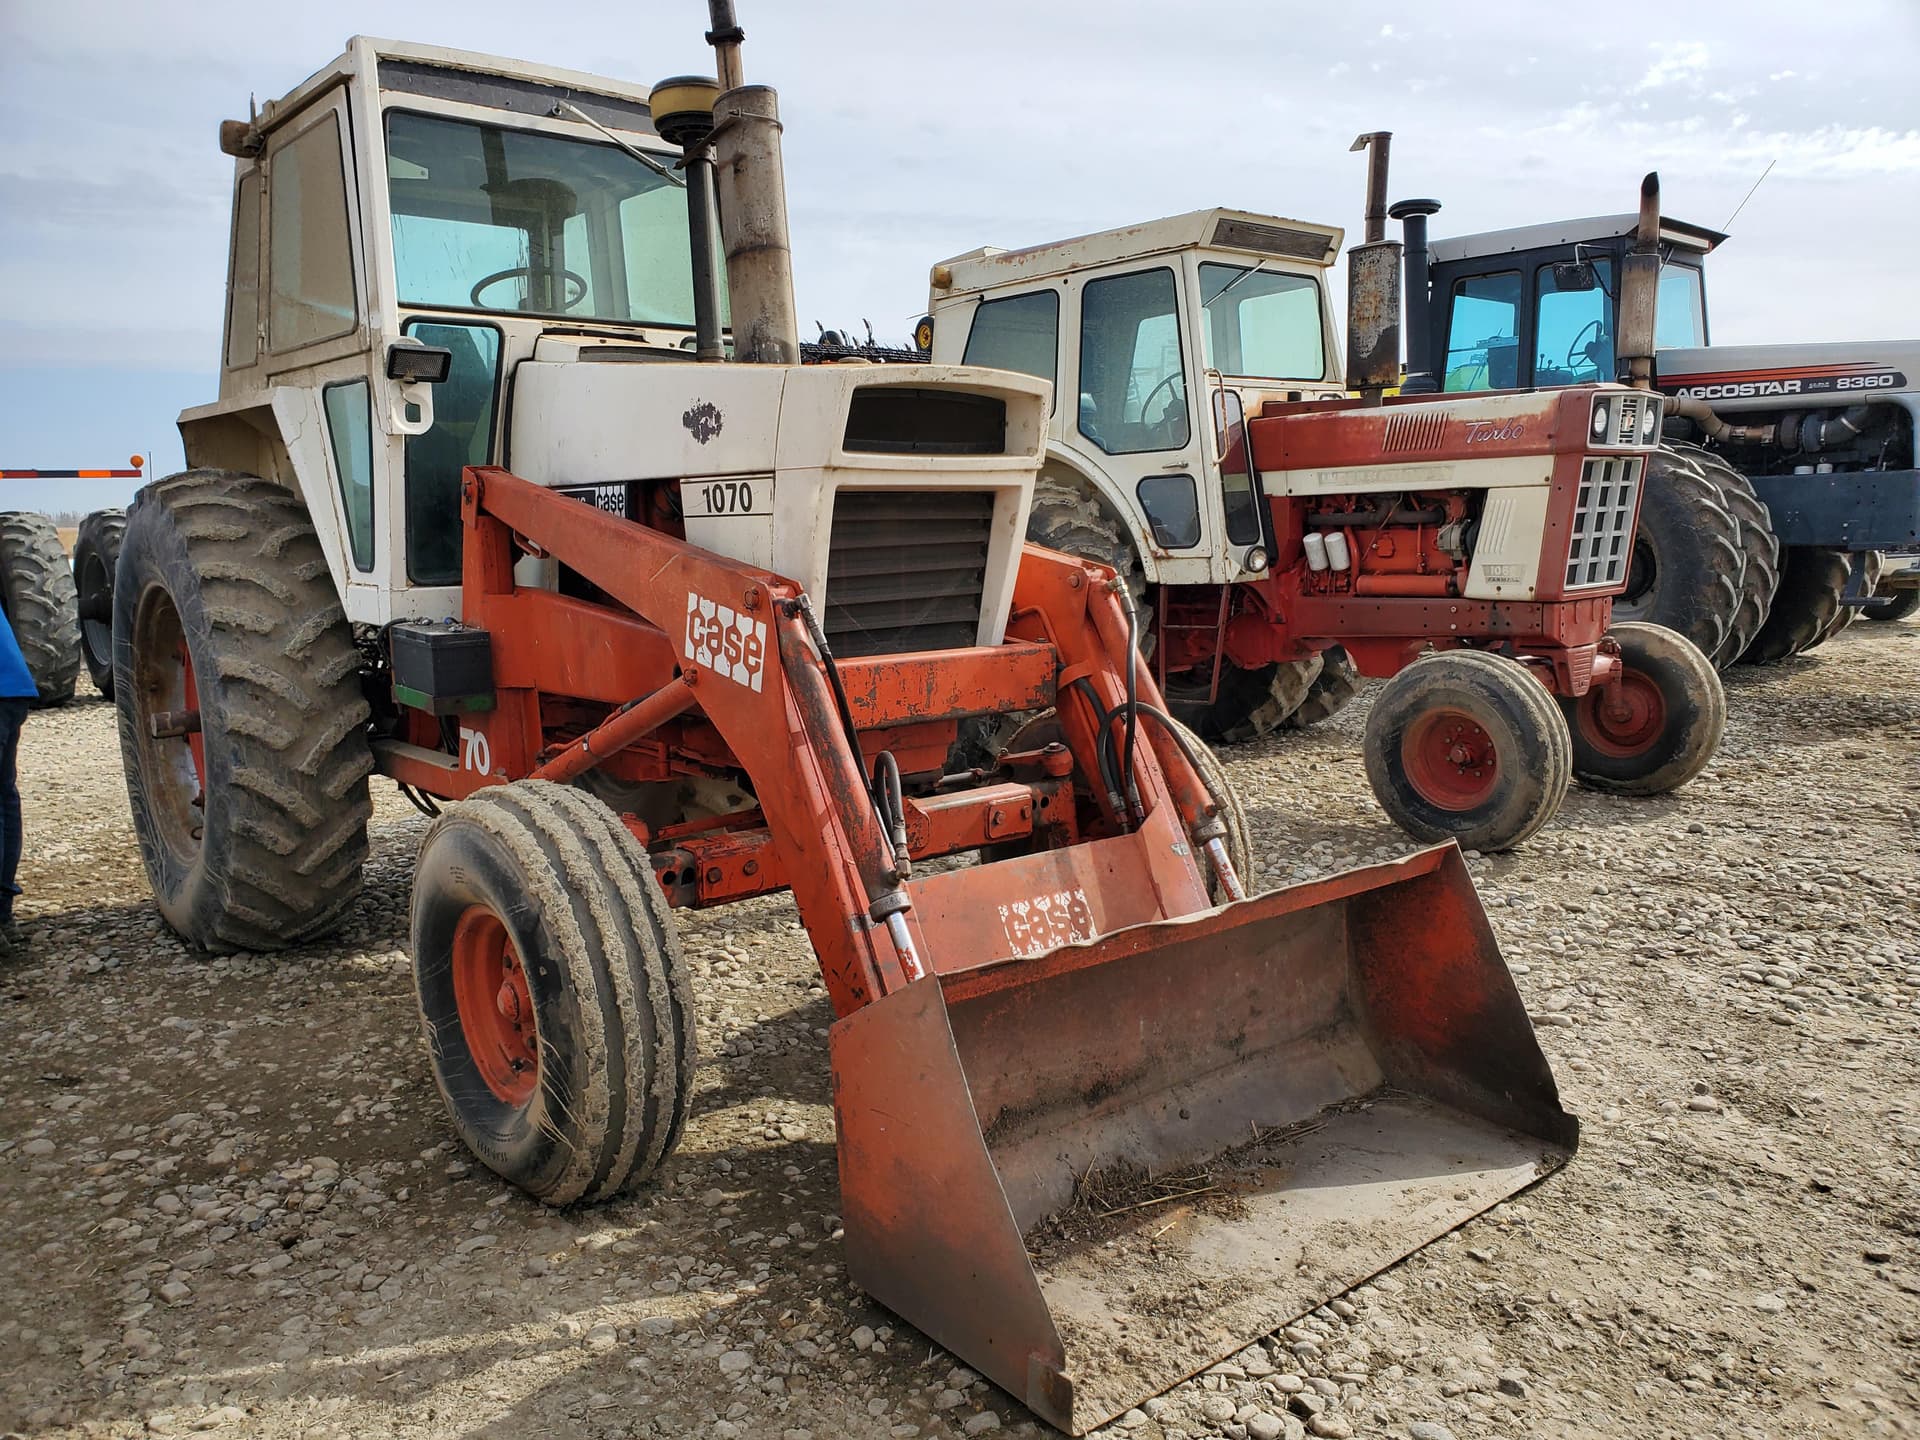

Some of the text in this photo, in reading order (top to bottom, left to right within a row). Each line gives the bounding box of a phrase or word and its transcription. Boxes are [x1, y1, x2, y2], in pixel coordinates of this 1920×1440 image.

[1676, 380, 1802, 400] AGCOSTAR
[1836, 375, 1894, 389] 8360
[1465, 418, 1524, 444] Turbo
[702, 482, 753, 513] 1070
[460, 726, 490, 776] 70
